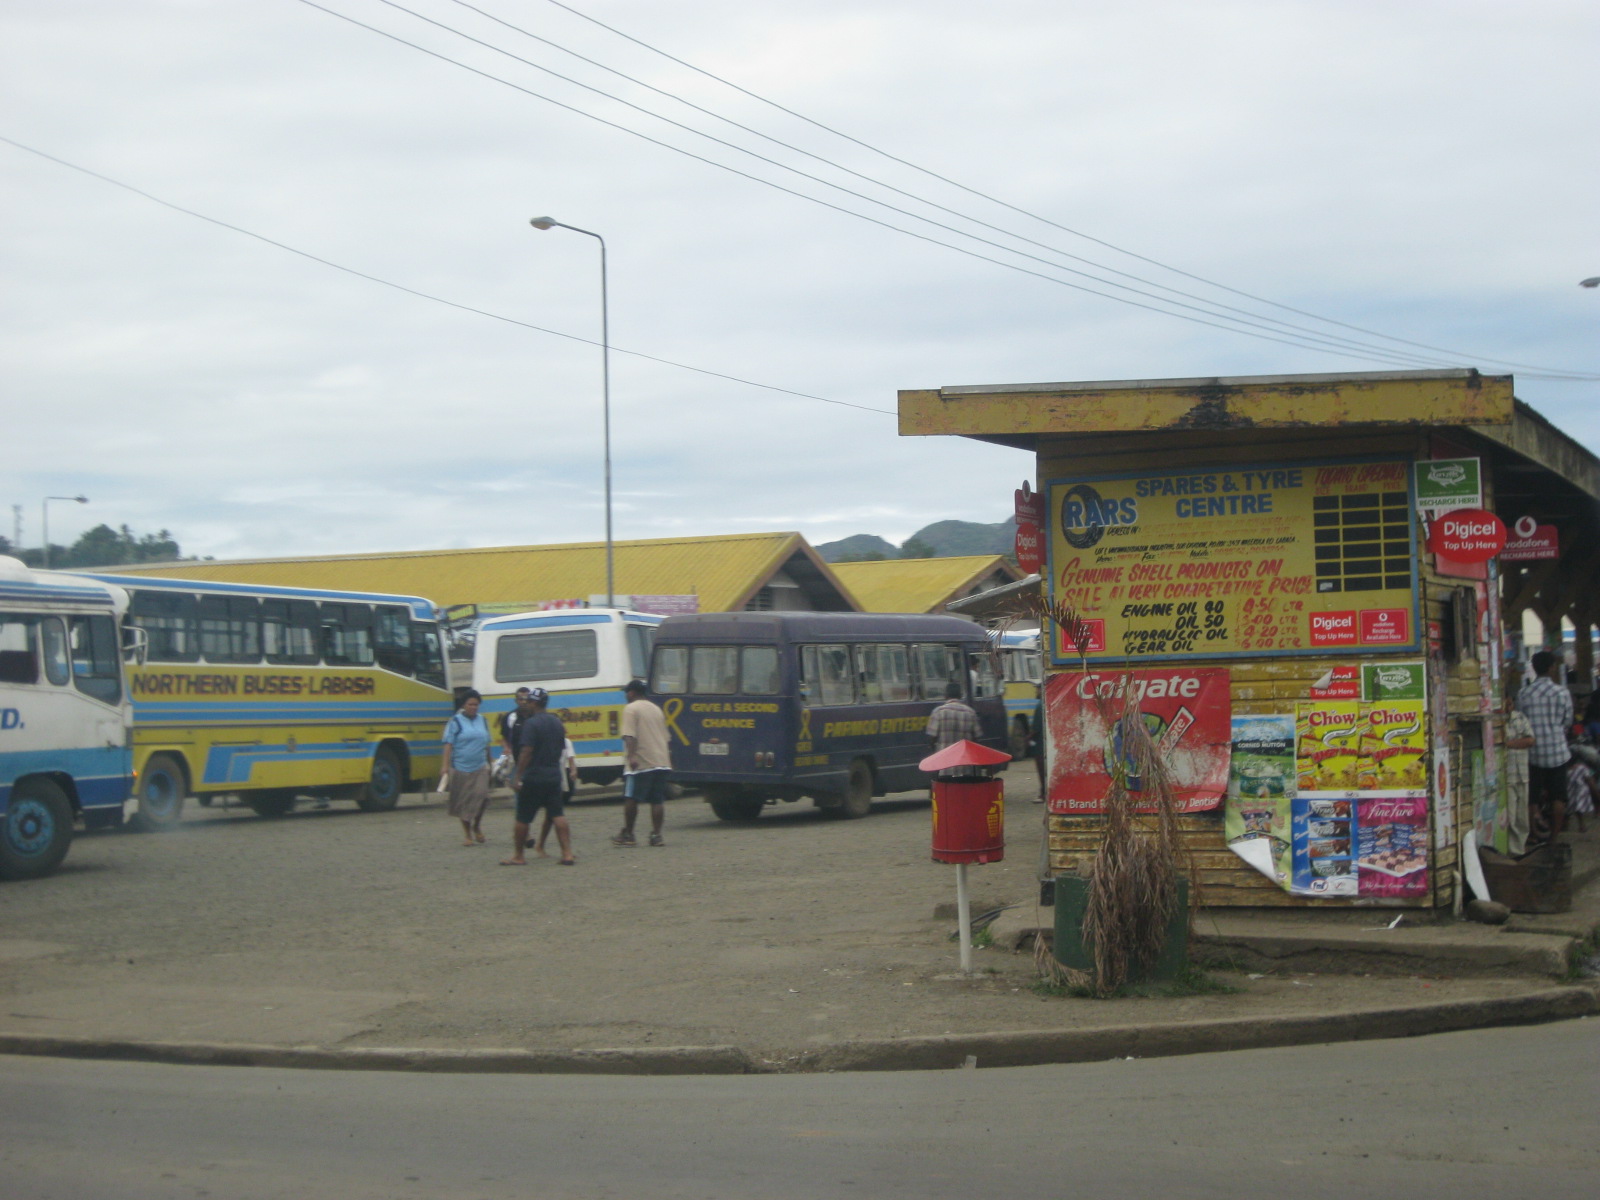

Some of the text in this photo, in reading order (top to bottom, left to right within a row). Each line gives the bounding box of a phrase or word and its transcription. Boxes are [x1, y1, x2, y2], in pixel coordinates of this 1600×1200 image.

[1135, 469, 1302, 497] SPARES & TYRE
[1063, 497, 1137, 529] RARS
[1175, 493, 1273, 518] CENTRE
[1443, 521, 1496, 539] Digicel
[1017, 533, 1037, 551] Digicel
[1443, 541, 1498, 550] Top Up Here
[1504, 539, 1550, 549] vodafone
[1128, 563, 1174, 582] SHELL
[1176, 560, 1252, 580] PRODUCTS
[1256, 558, 1284, 577] ON
[1128, 583, 1162, 600] VERY
[1121, 603, 1174, 618] ENGINE
[1176, 601, 1198, 616] OIL
[1175, 614, 1225, 631] OIL 50
[1313, 616, 1352, 630] Digicel
[1205, 628, 1229, 641] OIL
[1314, 631, 1355, 641] Top Up Here
[1124, 640, 1194, 655] GEAR OIL
[132, 673, 237, 695] NORTHERN
[1076, 674, 1200, 701] Colgate
[691, 703, 779, 714] GIVE A SECOND
[0, 708, 26, 730] D.
[702, 718, 756, 729] CHANCE
[1309, 711, 1356, 727] Chow
[1369, 709, 1417, 726] Chow
[1056, 800, 1067, 808] #1
[1069, 799, 1097, 809] Brand
